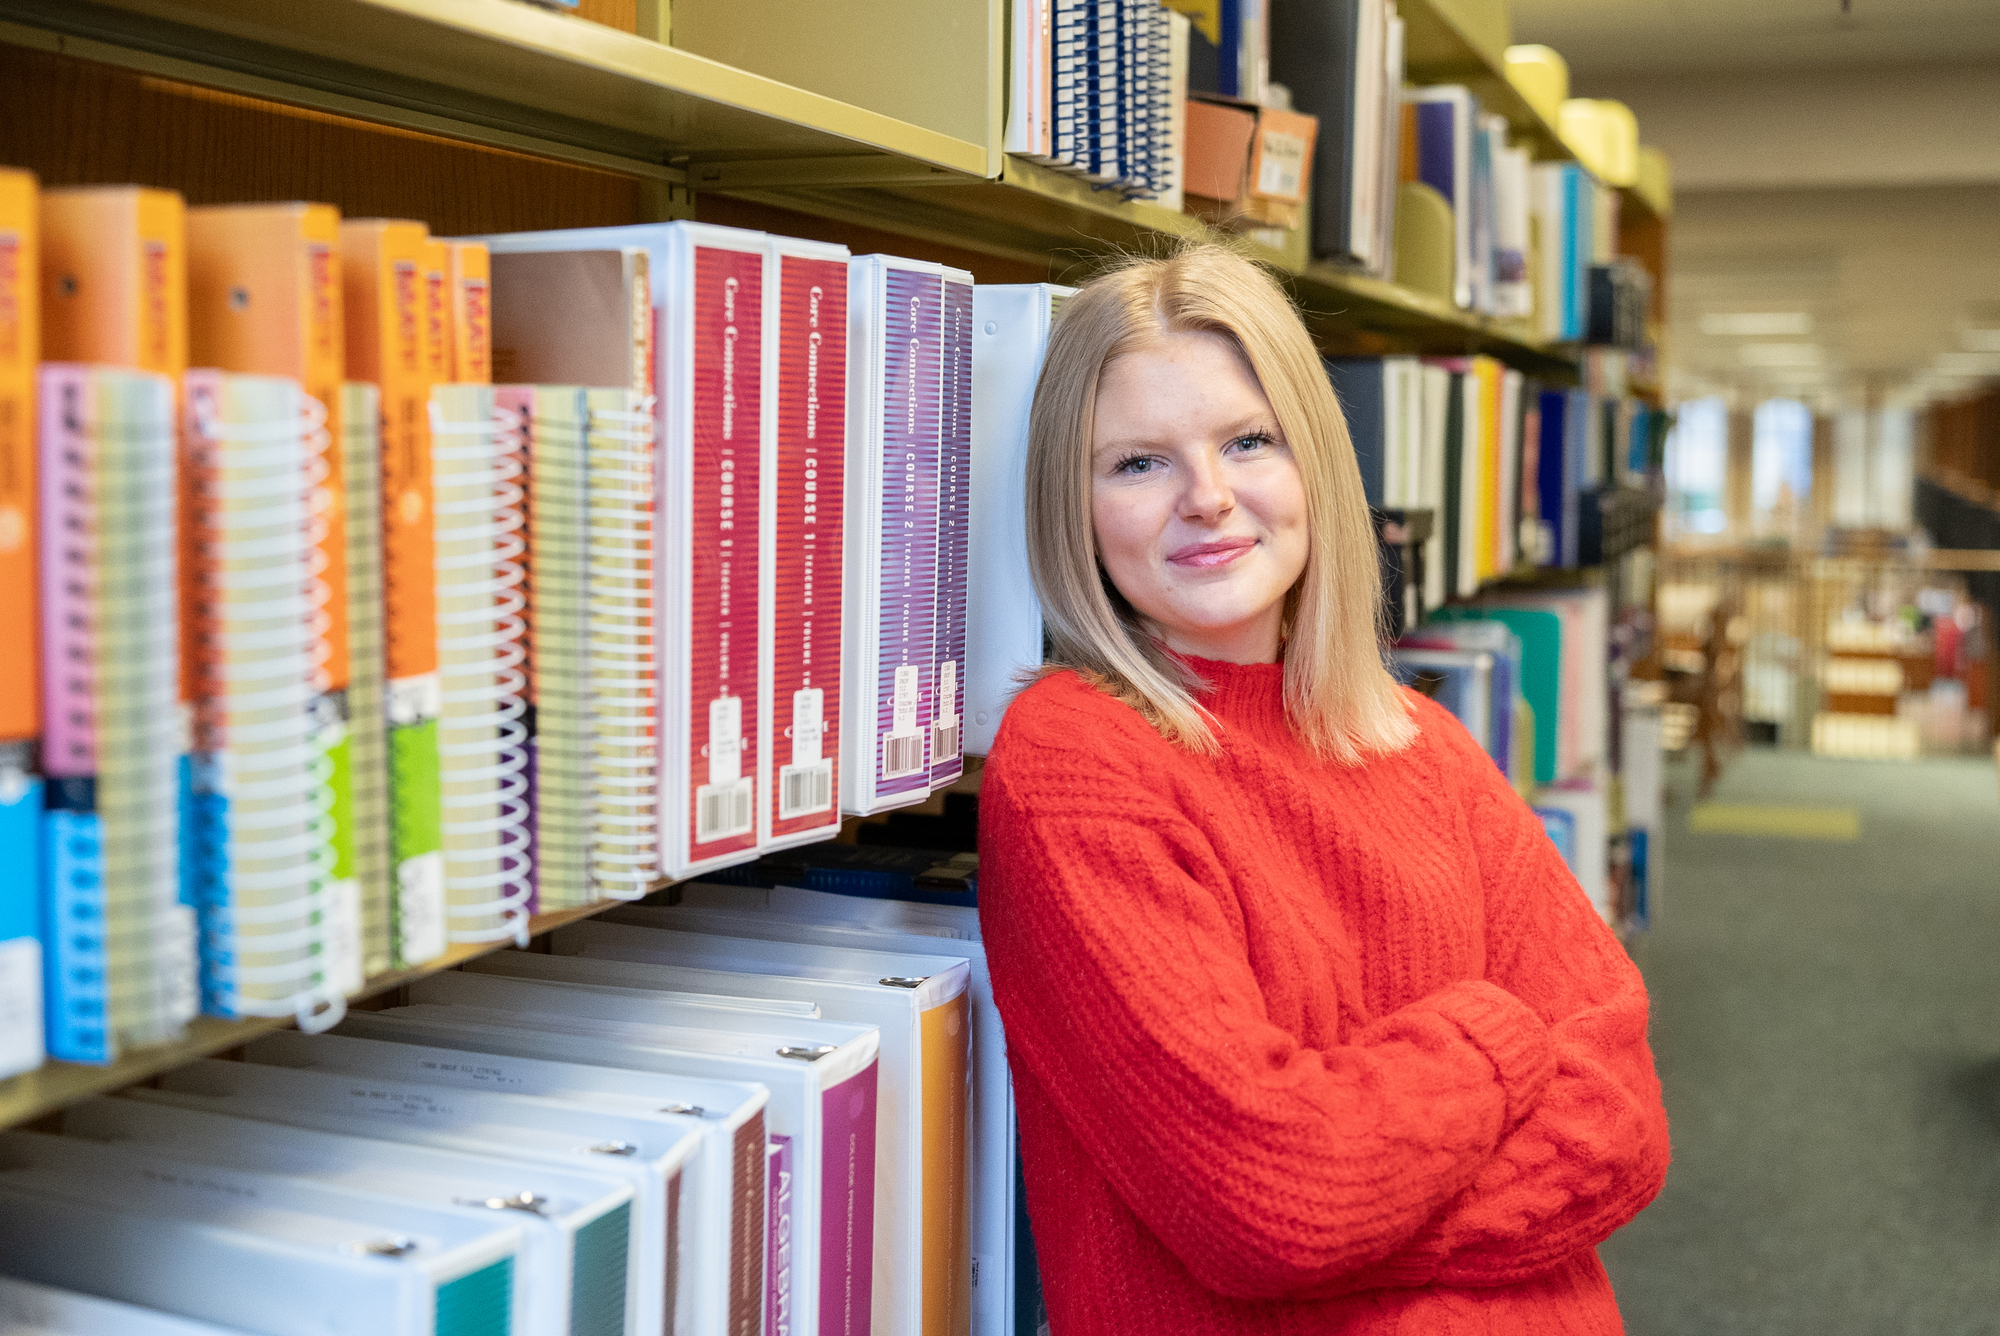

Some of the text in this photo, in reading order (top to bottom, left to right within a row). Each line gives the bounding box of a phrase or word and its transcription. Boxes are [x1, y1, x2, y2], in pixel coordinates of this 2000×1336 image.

[724, 277, 739, 323] Core
[809, 285, 823, 328] Core
[909, 296, 921, 333] Core
[954, 307, 962, 342] Core
[723, 326, 739, 440] Connections
[807, 332, 822, 439] Connections
[907, 337, 920, 435] Connections
[952, 346, 961, 438] Connections
[720, 459, 734, 531] COURSE
[804, 457, 817, 525] COURSE
[904, 452, 916, 513] COURSE
[949, 455, 957, 512] COURSE
[904, 521, 914, 529] 2
[903, 541, 911, 588] TEACHER
[802, 620, 812, 666] VOLUME
[902, 602, 910, 643] VOLUME
[847, 1132, 856, 1188] COLLEGE
[845, 1189, 855, 1273] PREPARATORY
